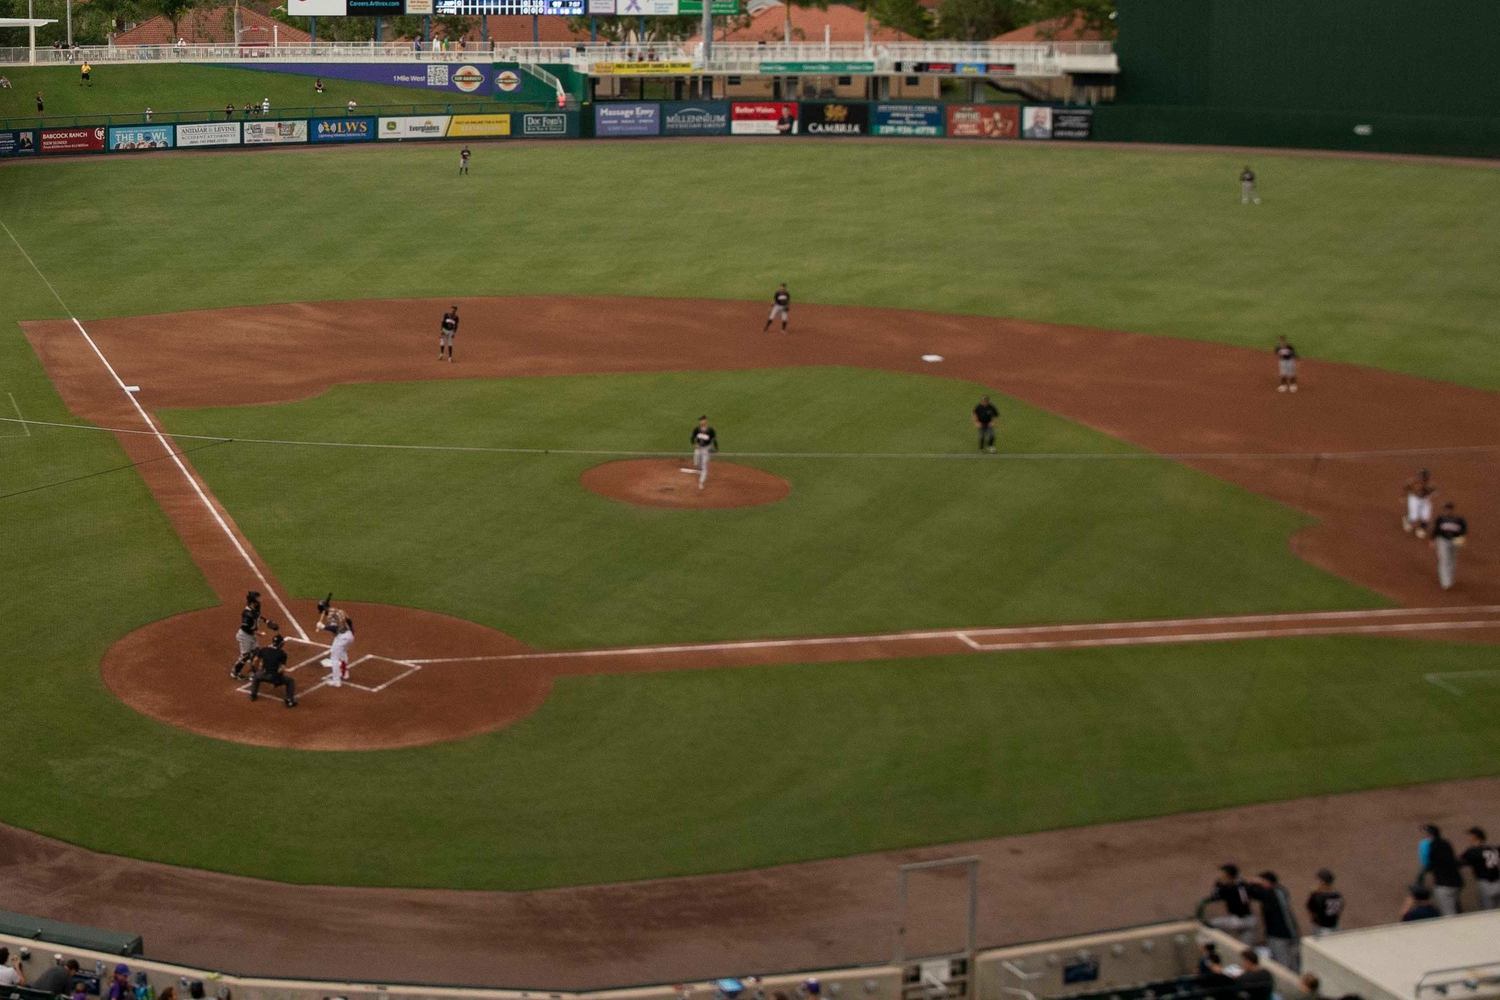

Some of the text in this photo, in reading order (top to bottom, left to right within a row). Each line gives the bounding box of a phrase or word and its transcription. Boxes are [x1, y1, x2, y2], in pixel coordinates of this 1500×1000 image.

[600, 107, 654, 118] Massage Envy
[542, 117, 562, 126] Ford's
[666, 113, 726, 122] MILLENNIUM
[337, 122, 367, 133] LWS
[409, 124, 440, 133] Everglades
[808, 123, 860, 133] CAMBRIA
[115, 132, 167, 141] THE BOWL
